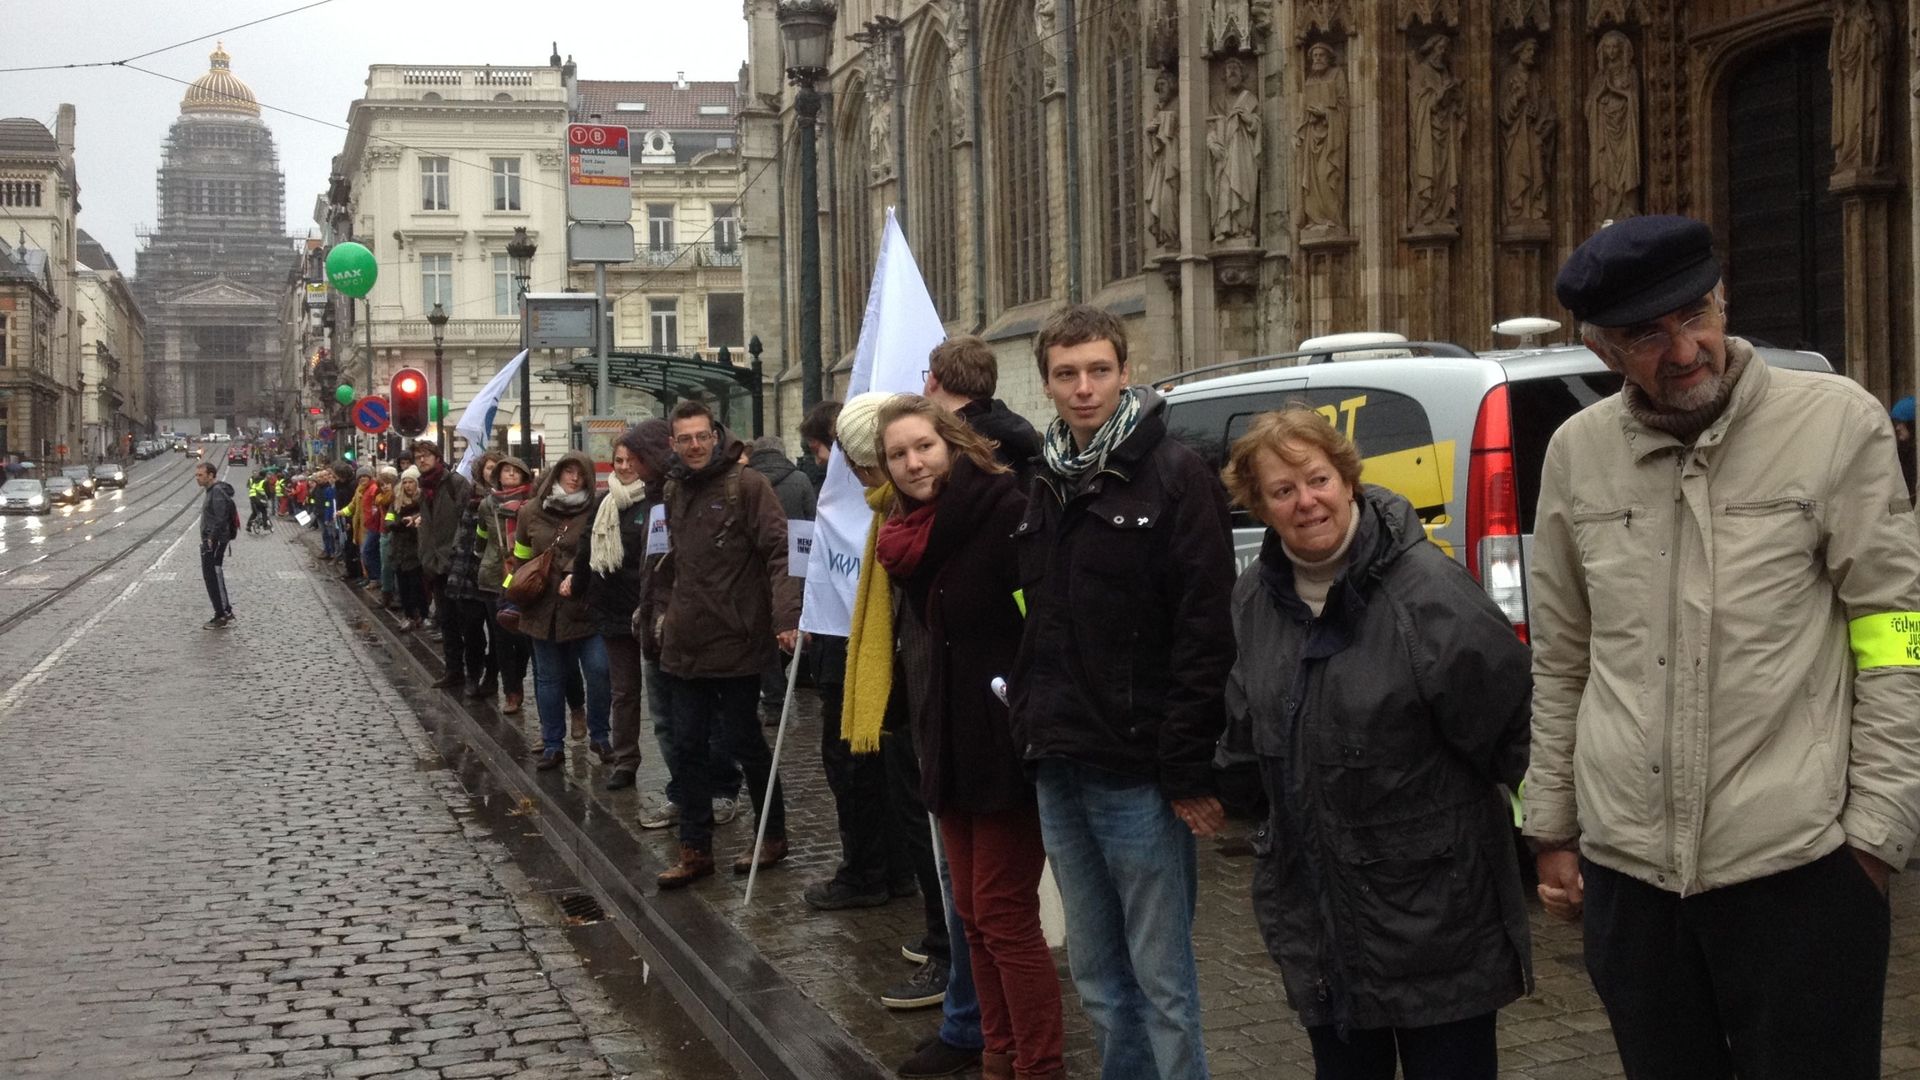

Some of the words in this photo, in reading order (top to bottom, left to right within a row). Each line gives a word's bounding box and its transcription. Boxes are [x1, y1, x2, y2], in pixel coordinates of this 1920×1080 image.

[597, 148, 618, 156] Sablon
[570, 156, 580, 164] 92
[333, 269, 361, 280] MAX
